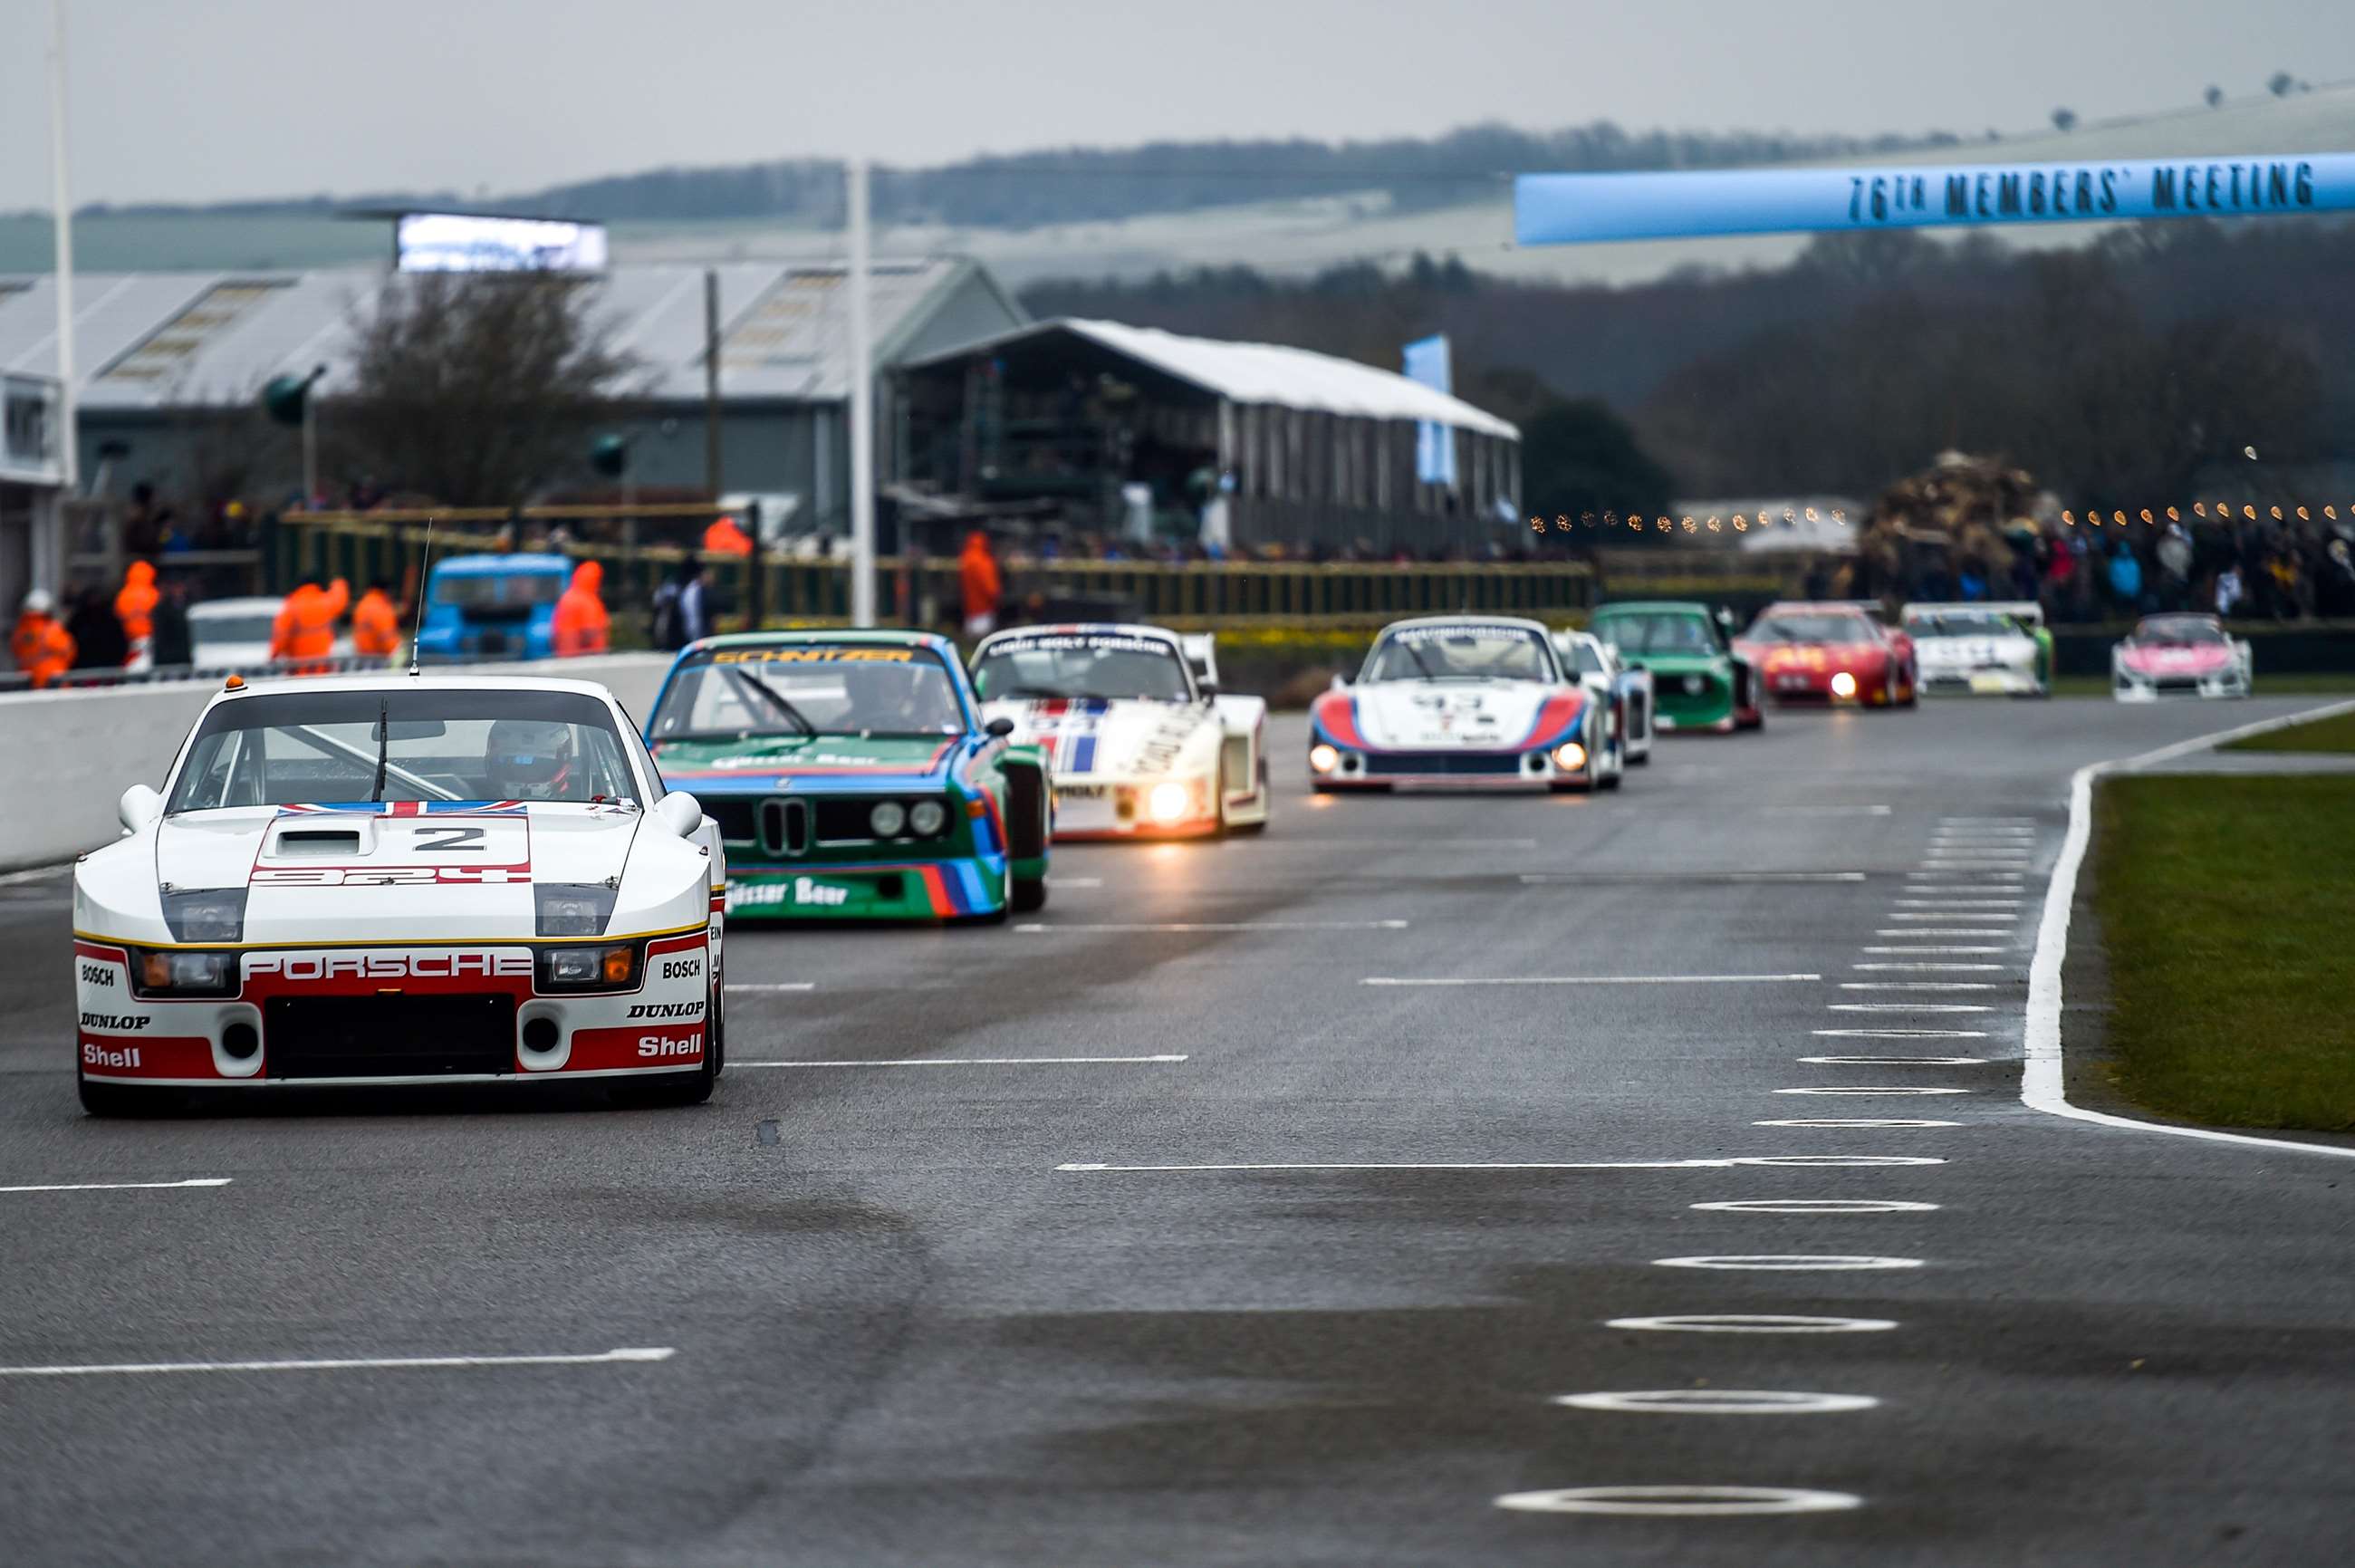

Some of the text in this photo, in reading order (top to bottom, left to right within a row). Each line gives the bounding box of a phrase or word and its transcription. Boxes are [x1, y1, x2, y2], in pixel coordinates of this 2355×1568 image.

[1945, 168, 2131, 216] MEMBERS'
[2152, 161, 2312, 209] MEETING
[714, 649, 914, 664] SCHNITZER
[413, 827, 487, 851] 2
[250, 866, 532, 886] 924
[82, 965, 114, 986] BOSCH
[240, 954, 533, 982] PORSCHE
[662, 958, 701, 979] BOSCH
[626, 1000, 705, 1018] DUNLOP
[80, 1012, 151, 1030] DUNLOP
[83, 1043, 141, 1068] Shell
[638, 1033, 702, 1057] Shell
